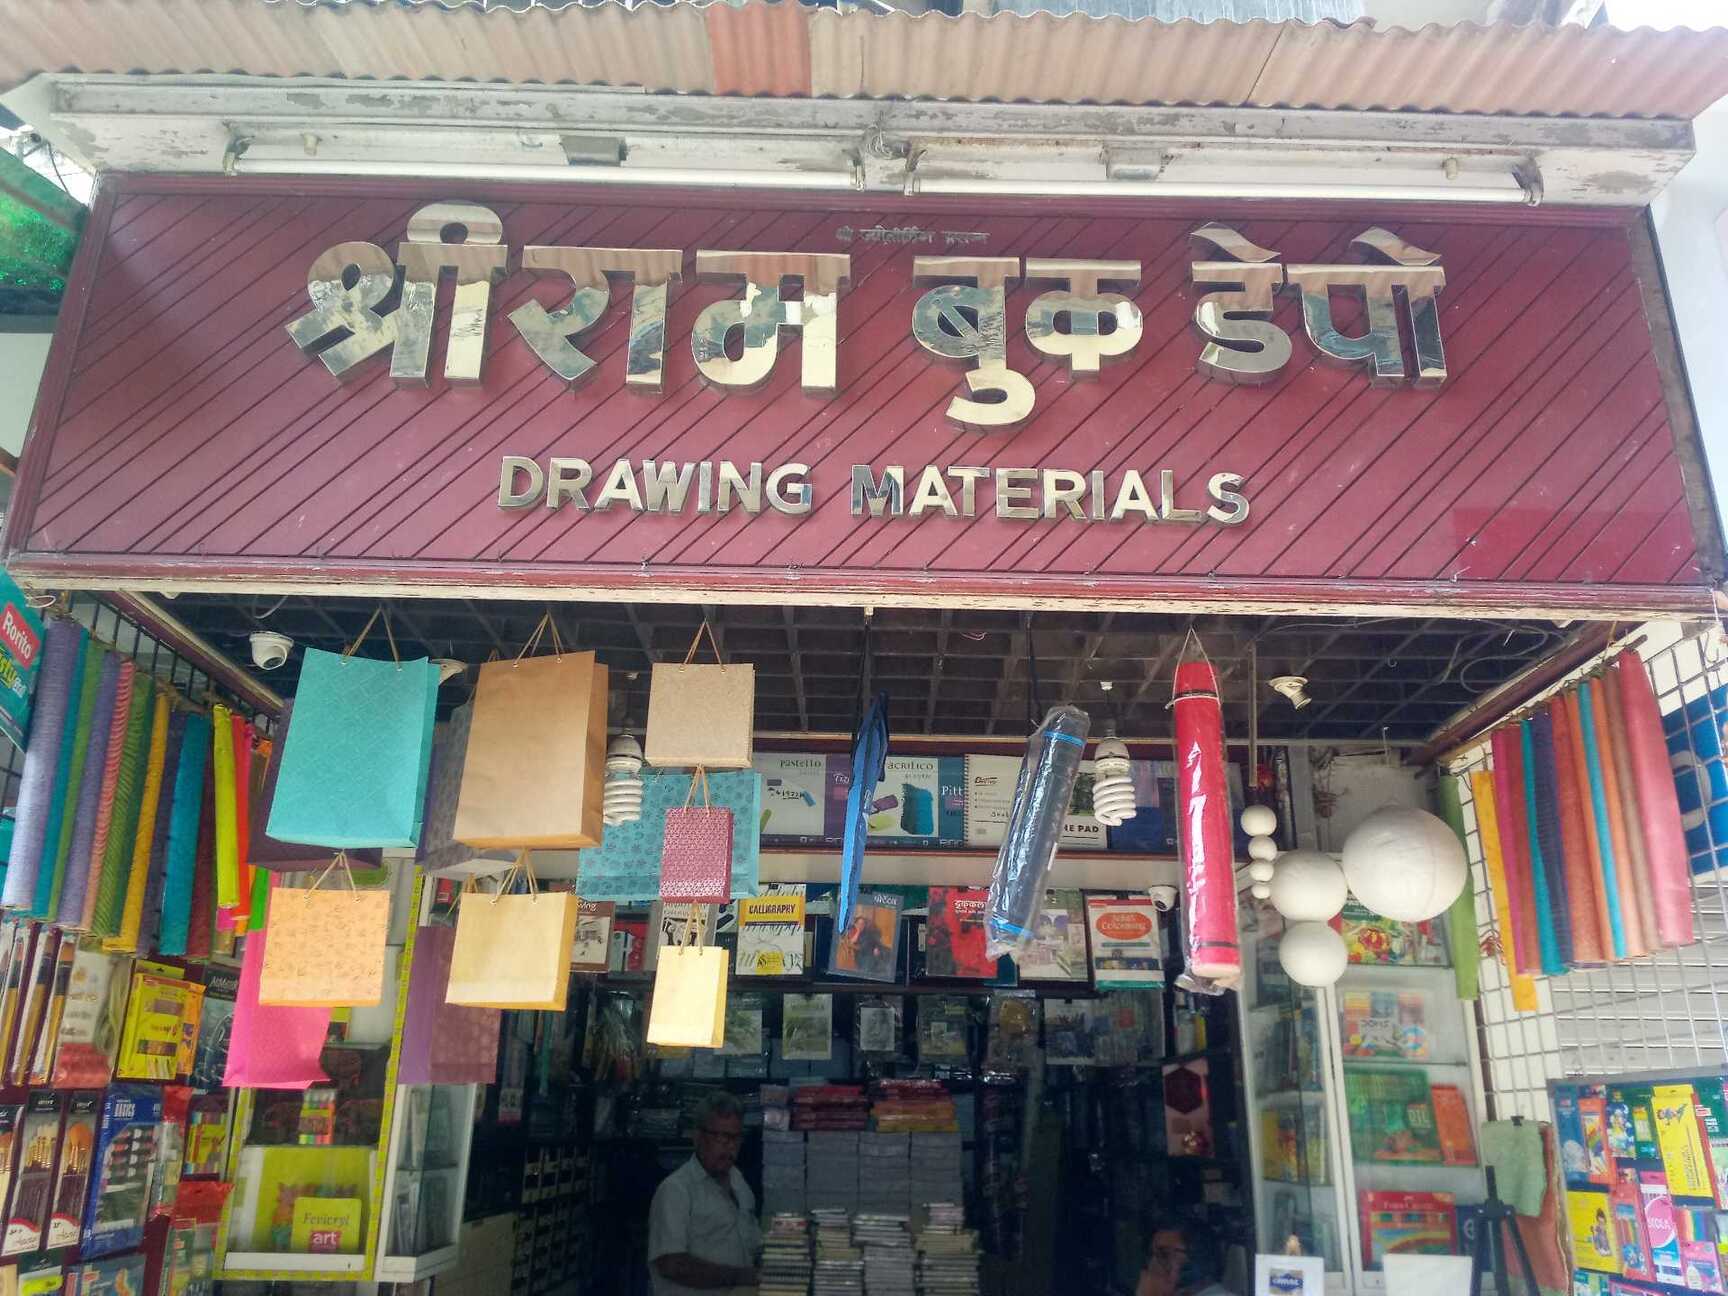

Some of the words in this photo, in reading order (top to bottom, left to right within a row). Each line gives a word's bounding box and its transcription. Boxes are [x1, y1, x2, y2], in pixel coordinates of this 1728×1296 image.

[285, 203, 852, 392] श्रीराम
[912, 255, 1144, 428] बुक
[1190, 222, 1448, 386] डेपो
[498, 456, 813, 515] DRAWING
[851, 464, 1250, 525] MATERIALS
[2, 610, 33, 660] Rorito
[749, 903, 796, 914] CALLIGRAPHY
[313, 1231, 337, 1245] art
